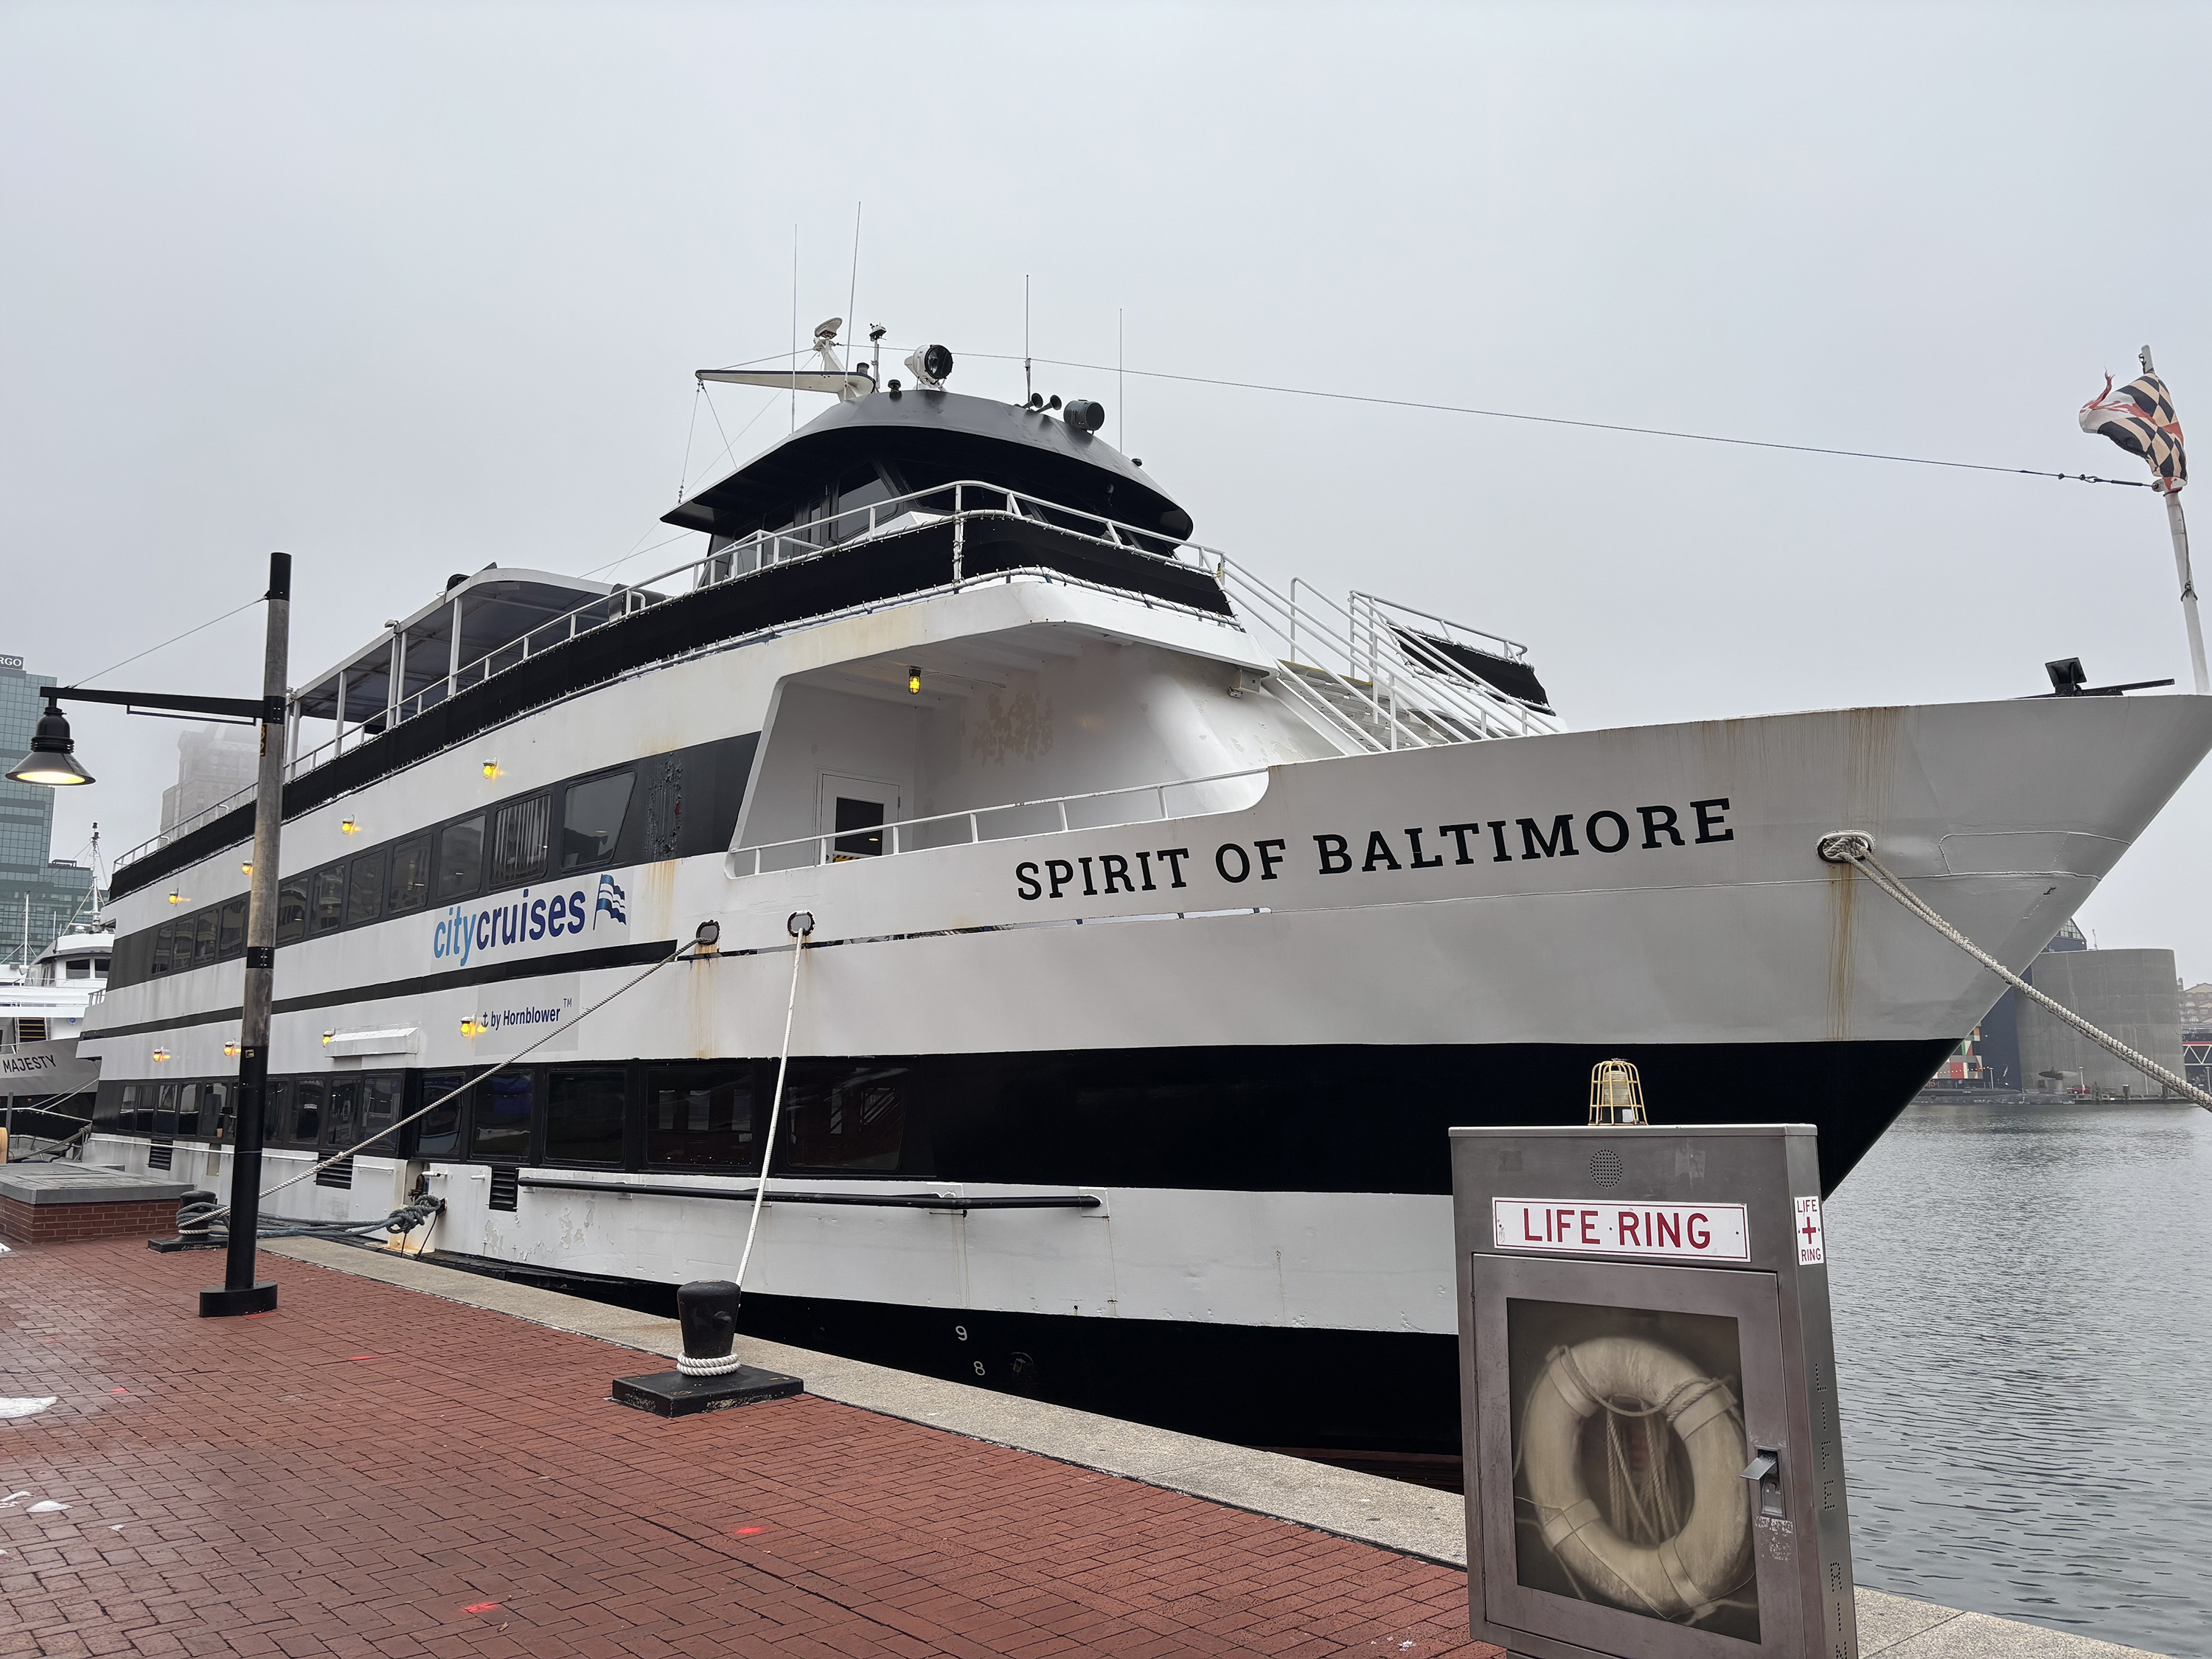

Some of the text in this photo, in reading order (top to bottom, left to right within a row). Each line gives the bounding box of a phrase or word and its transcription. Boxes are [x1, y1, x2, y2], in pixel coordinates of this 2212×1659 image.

[1015, 797, 1734, 901] SPIRIT OF BALTIMORE
[434, 888, 586, 967] citycruises
[490, 1011, 501, 1031] by
[503, 1006, 561, 1026] Hornblower
[2, 1054, 57, 1073] MAJESTY
[1797, 1199, 1818, 1213] LIFE
[1523, 1208, 1711, 1250] LIFE RING
[1801, 1248, 1821, 1262] RING
[955, 1326, 967, 1341] 9
[973, 1360, 985, 1376] 8
[1815, 1363, 1836, 1510] LIFE
